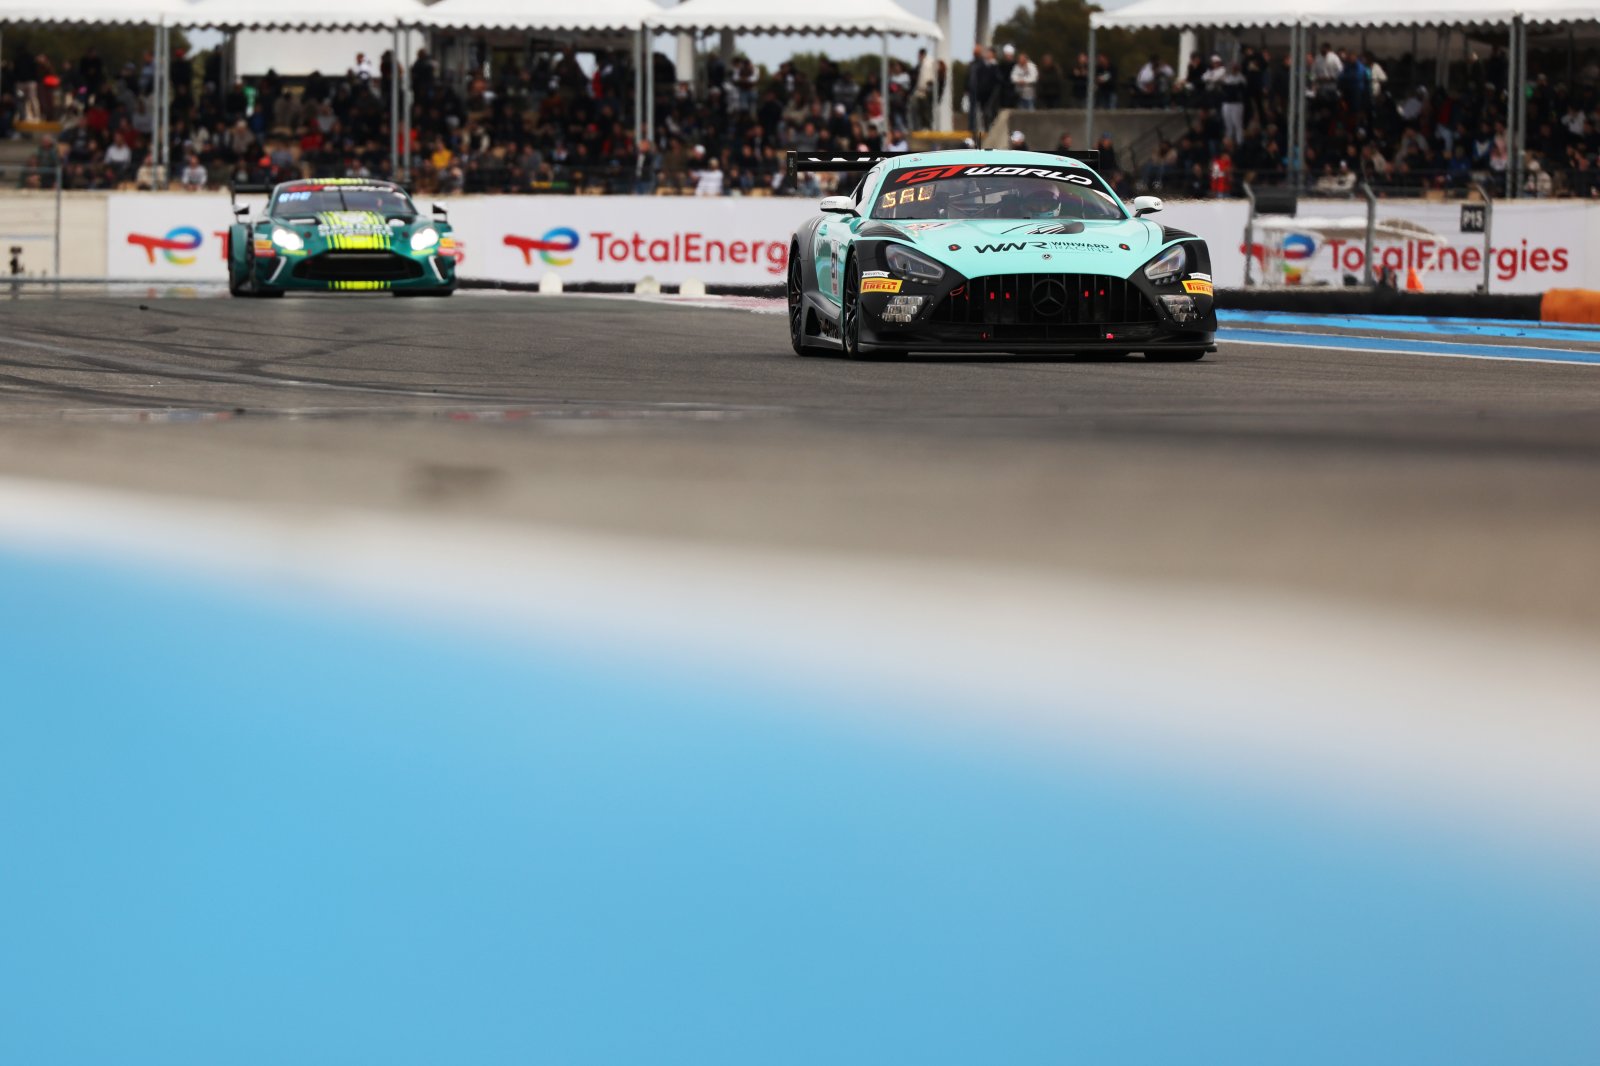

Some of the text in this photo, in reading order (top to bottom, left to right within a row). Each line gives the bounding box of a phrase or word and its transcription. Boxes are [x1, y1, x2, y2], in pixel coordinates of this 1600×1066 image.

[964, 166, 1093, 186] WORLD
[590, 232, 788, 275] TotalEnerg
[1051, 241, 1110, 249] WINWARD
[1328, 239, 1569, 281] ToalEnegies
[862, 281, 898, 290] PIRELLI
